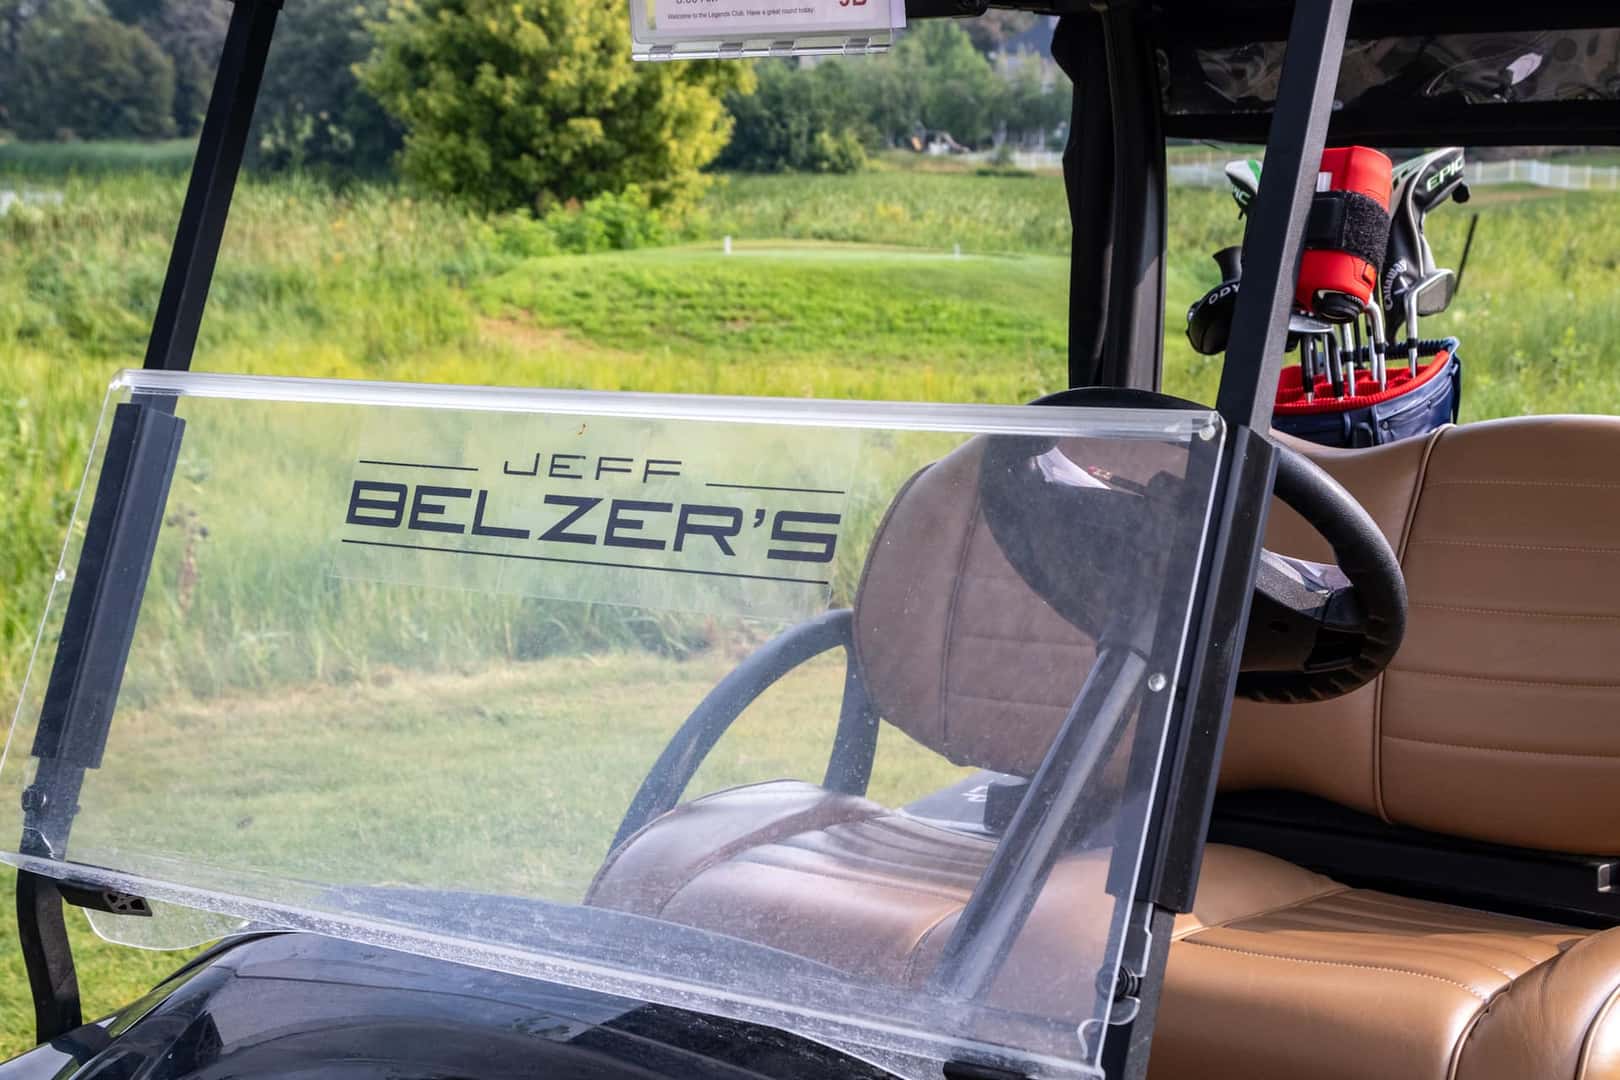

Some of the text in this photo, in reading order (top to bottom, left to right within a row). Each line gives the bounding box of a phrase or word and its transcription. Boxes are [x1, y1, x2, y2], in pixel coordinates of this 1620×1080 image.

[707, 11, 730, 19] Legends
[767, 8, 780, 16] great
[1426, 154, 1464, 192] EPIC
[503, 452, 682, 483] JEFF
[345, 479, 842, 564] BELZER'S
